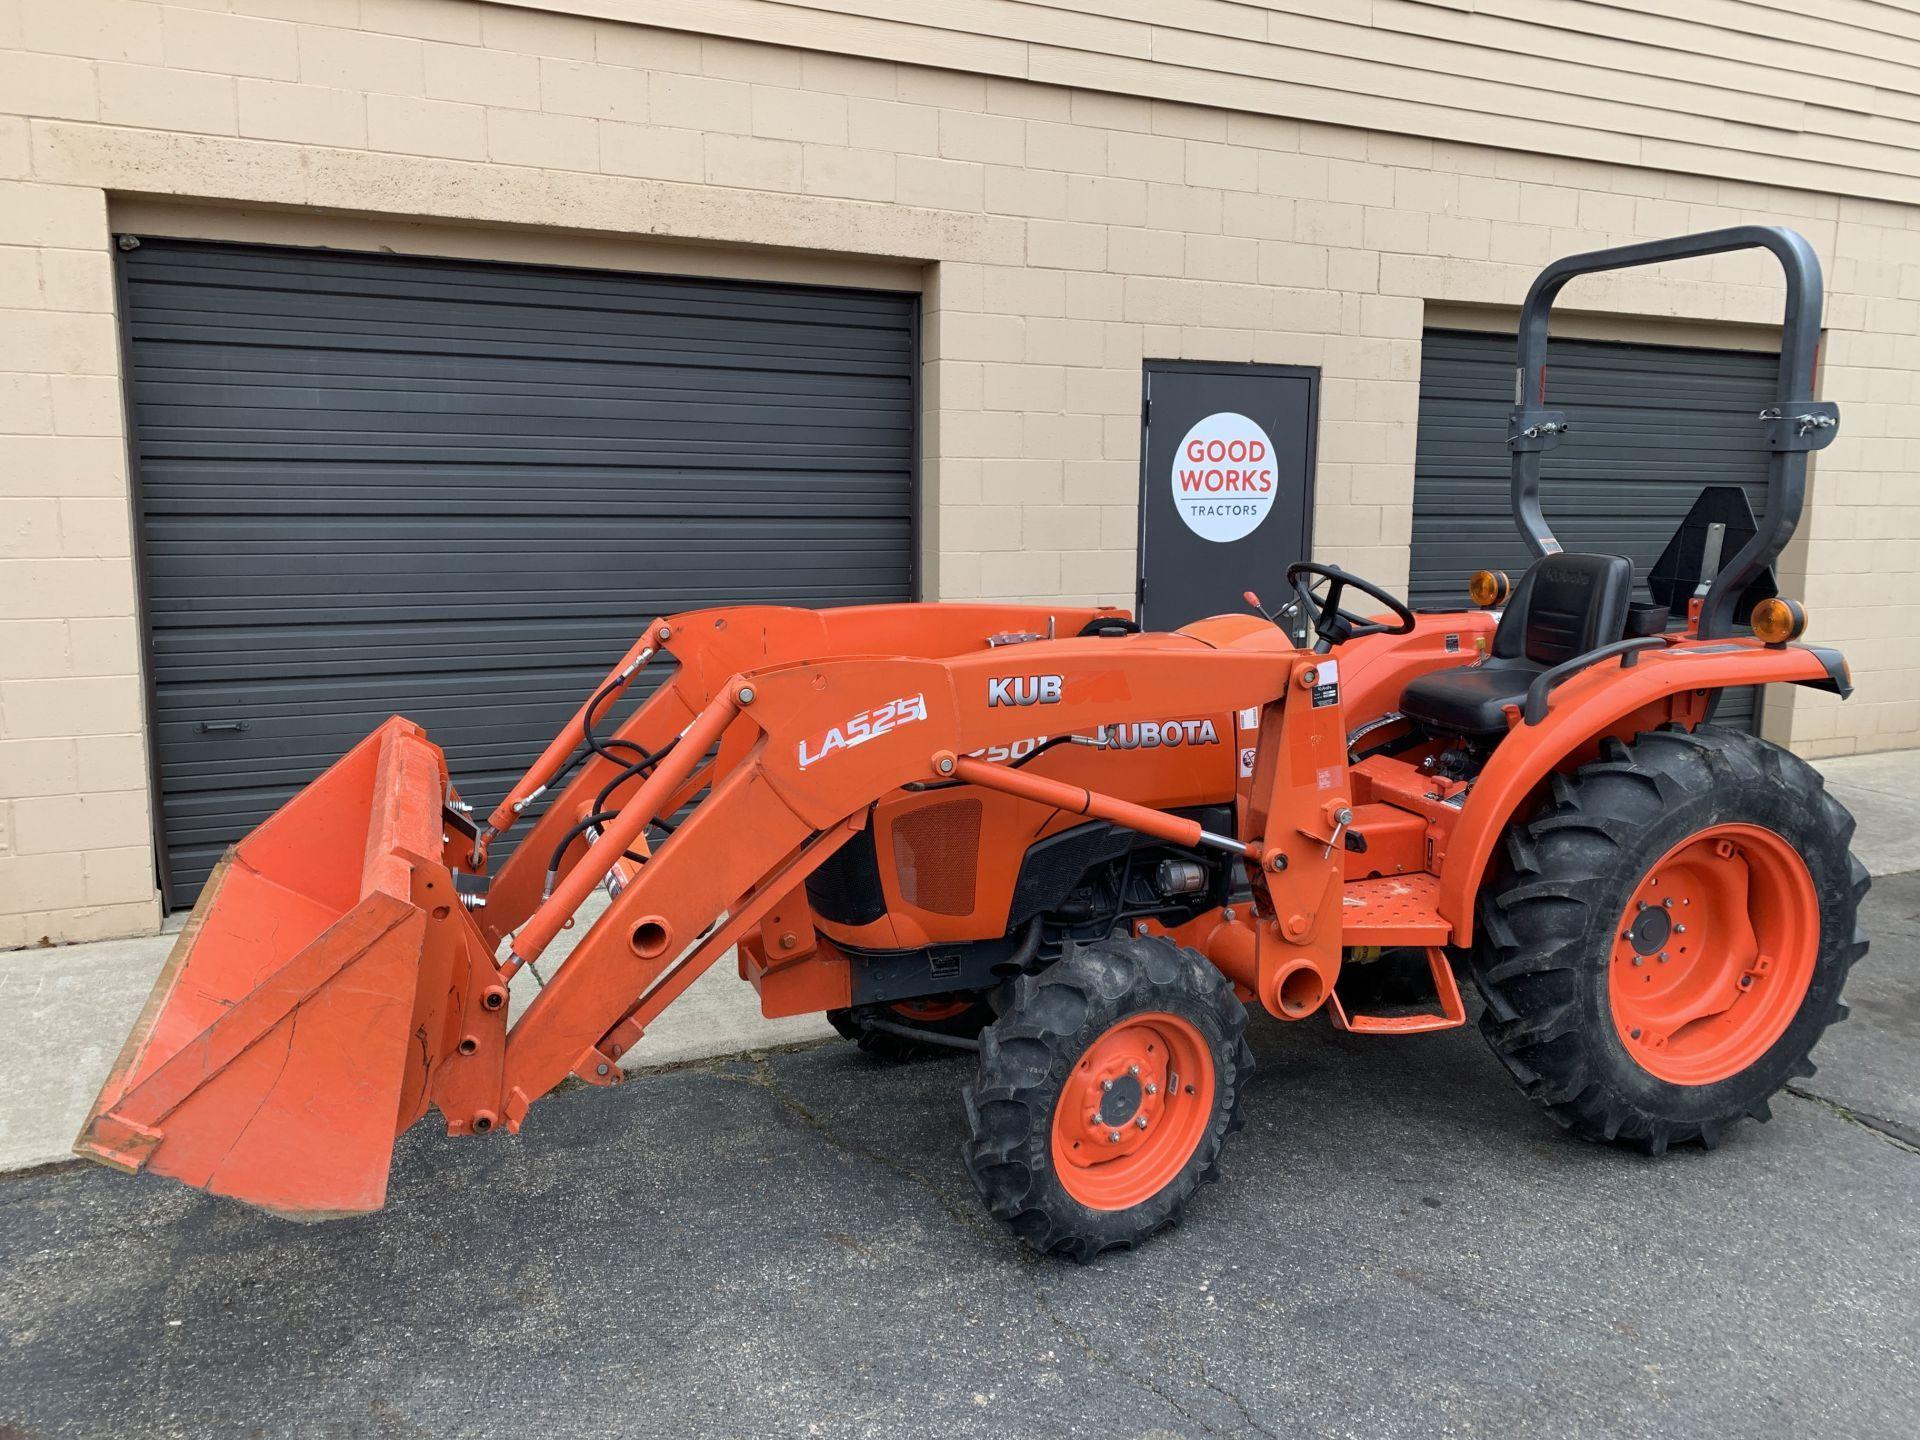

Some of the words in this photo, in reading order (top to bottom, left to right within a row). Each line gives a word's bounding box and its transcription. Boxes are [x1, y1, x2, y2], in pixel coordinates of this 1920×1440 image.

[1186, 439, 1266, 463] GOOD
[1179, 469, 1272, 493] WORKS
[1190, 505, 1257, 516] TRACTORS
[799, 695, 922, 767] LA525
[1097, 718, 1220, 750] KUBOTA
